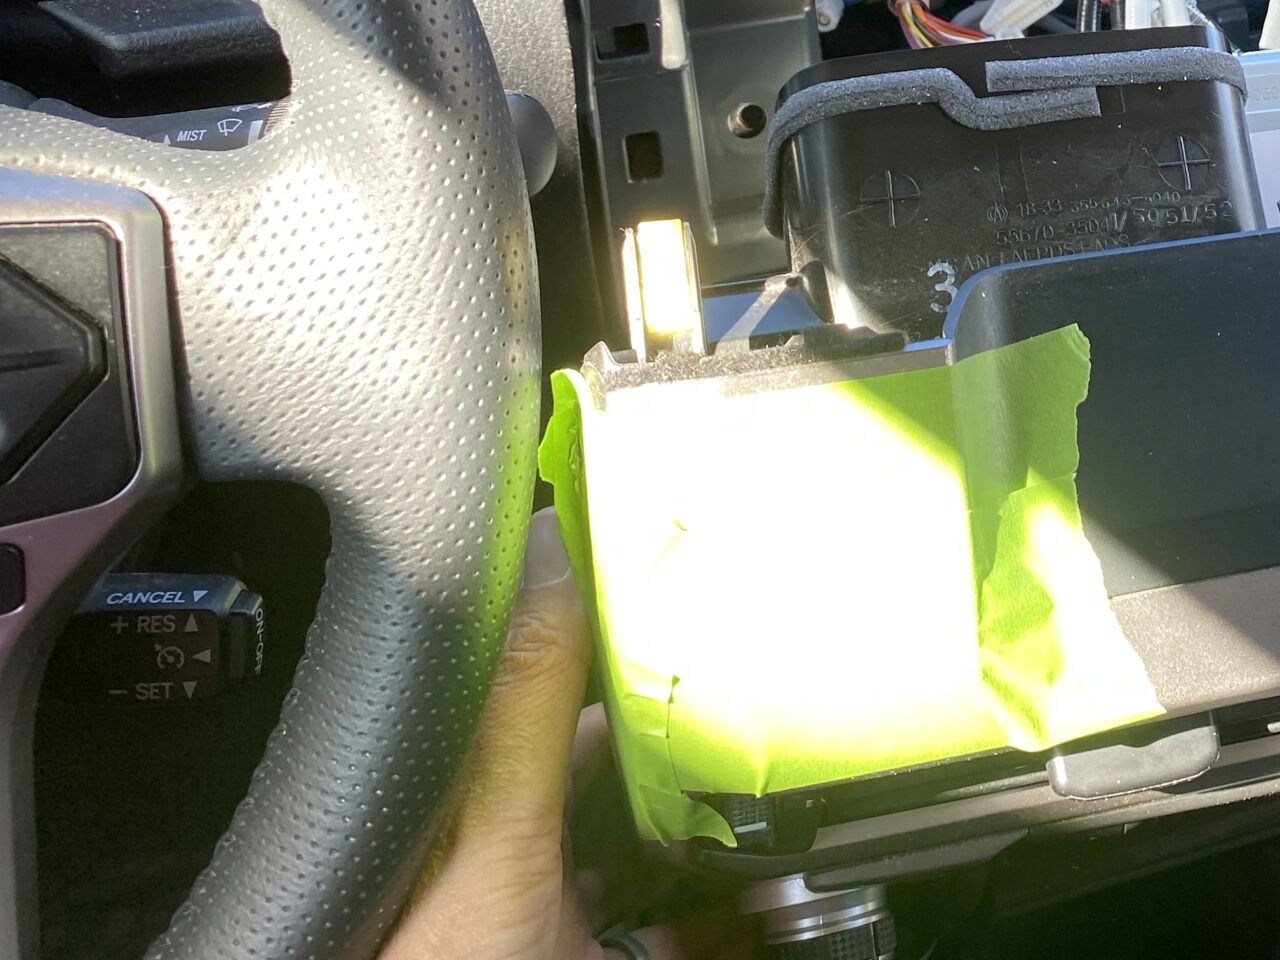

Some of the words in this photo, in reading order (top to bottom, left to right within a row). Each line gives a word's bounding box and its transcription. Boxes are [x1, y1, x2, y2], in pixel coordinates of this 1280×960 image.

[177, 129, 207, 142] MIST
[106, 591, 185, 605] CANCEL
[137, 615, 176, 633] RES
[254, 607, 264, 676] ON-OFF
[135, 682, 173, 700] SET
